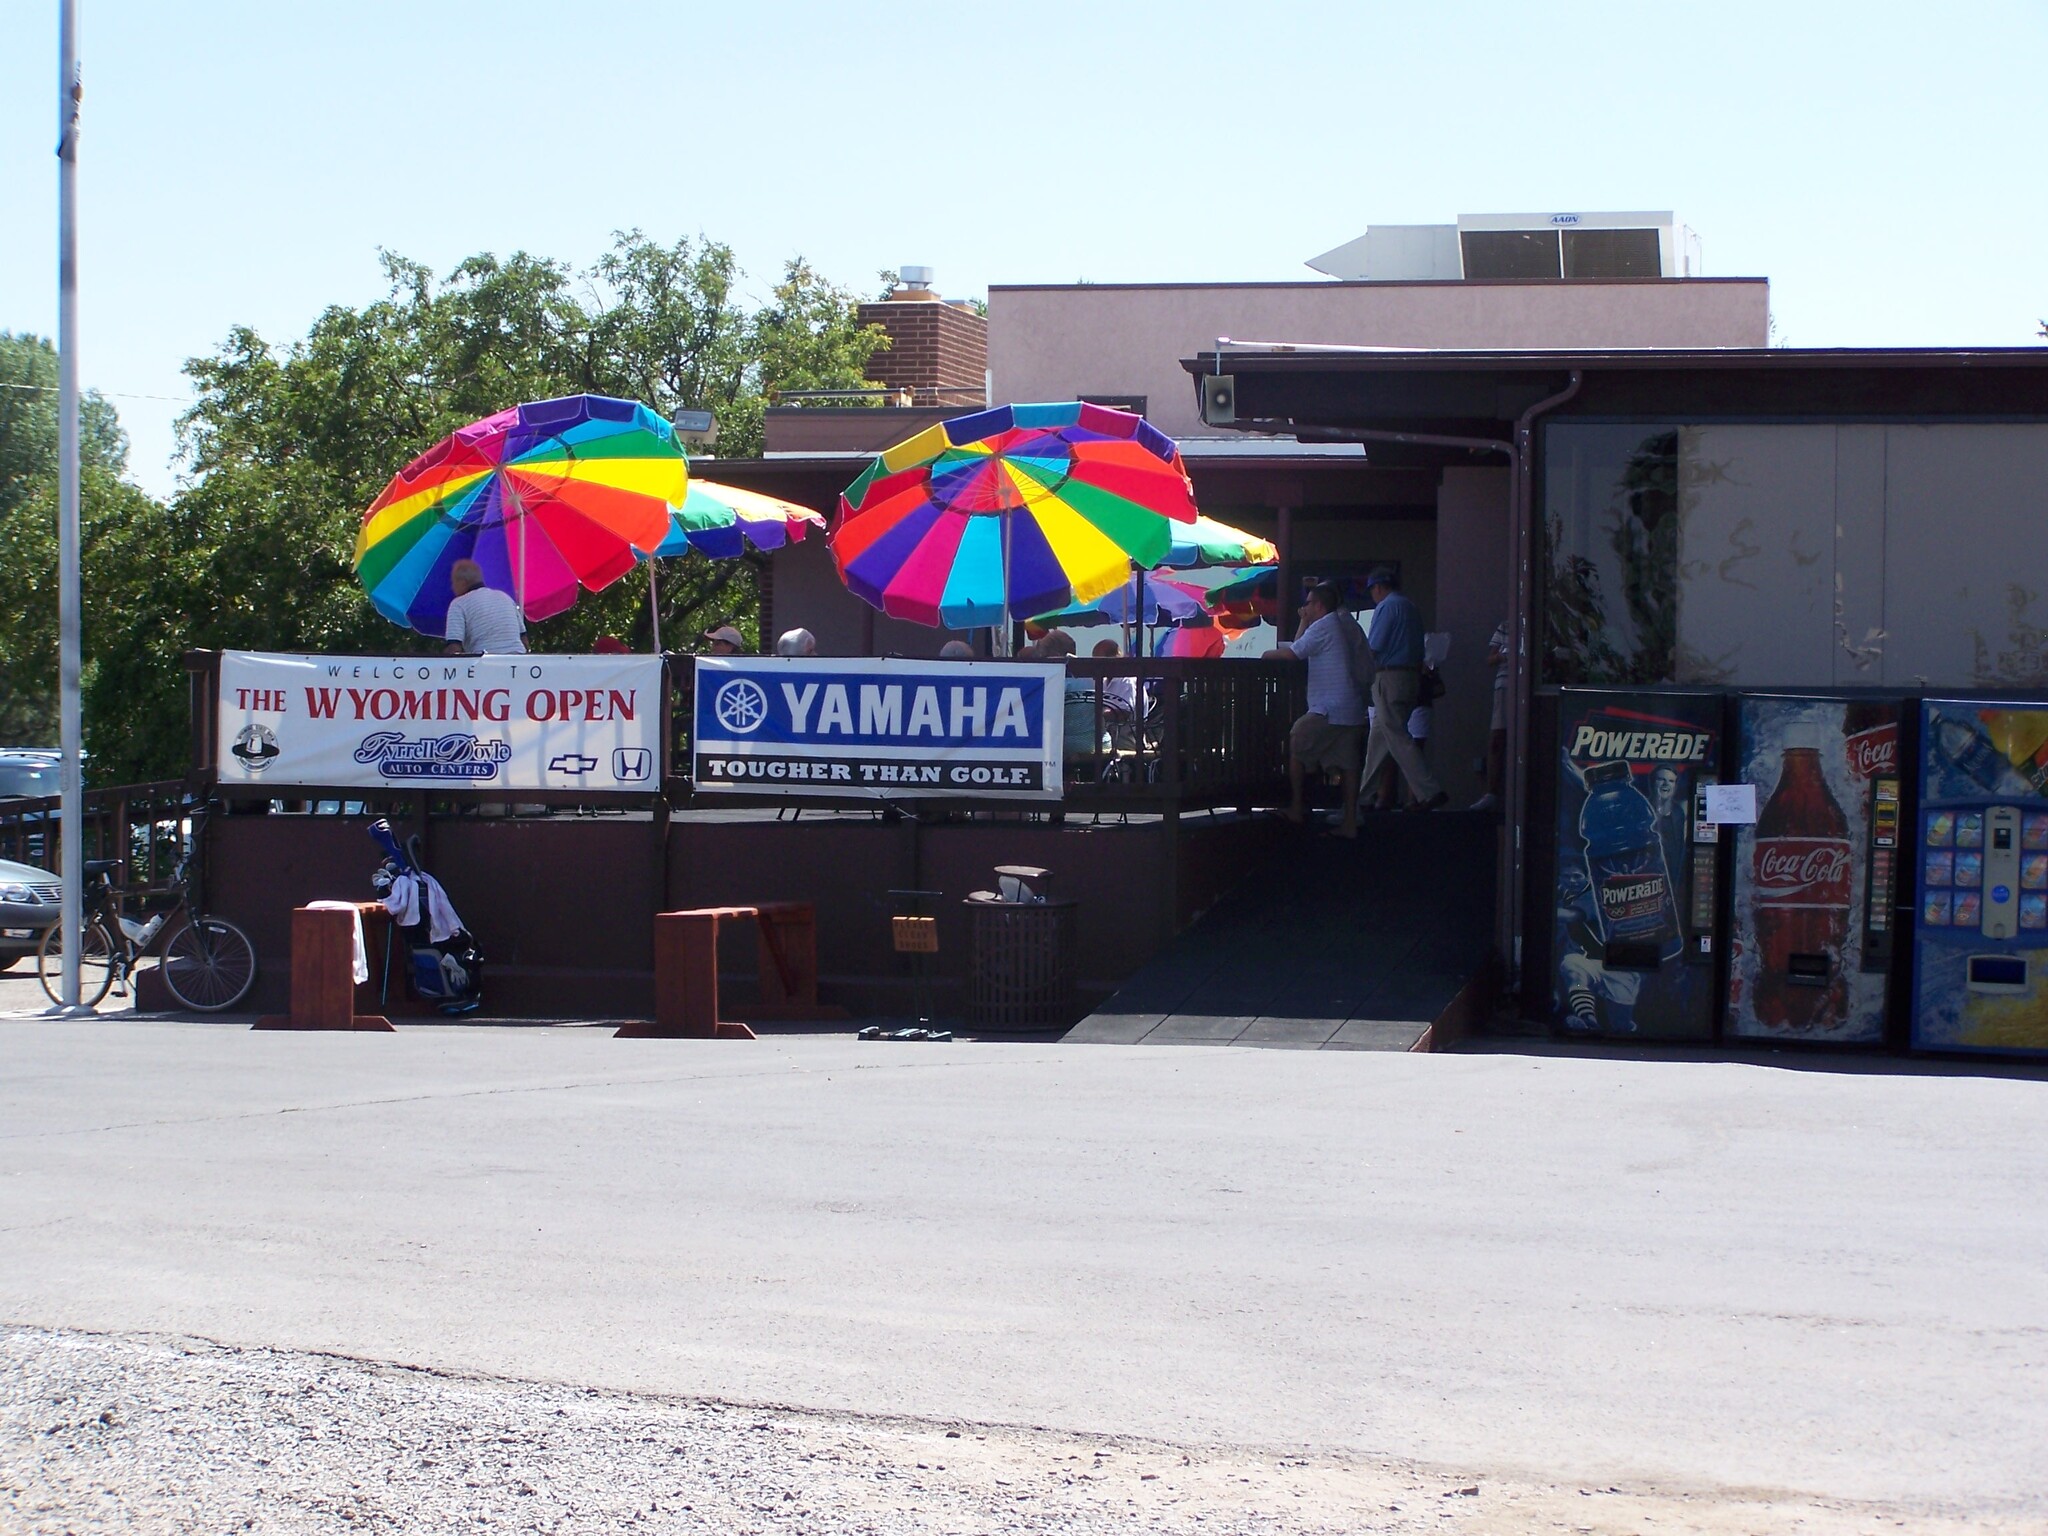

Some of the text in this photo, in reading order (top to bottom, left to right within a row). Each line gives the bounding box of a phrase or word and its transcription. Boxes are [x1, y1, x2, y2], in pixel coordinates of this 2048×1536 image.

[328, 664, 543, 681] WELCOME TO
[236, 686, 637, 722] THE WYOMING OPEN
[780, 682, 1030, 738] YAMAHA
[354, 731, 512, 764] Tyrrell Doyle
[388, 764, 489, 775] AUTO CENTERS
[708, 759, 1032, 785] TOUGHER THAN GOLF.
[1760, 847, 1850, 883] Coca-Cola
